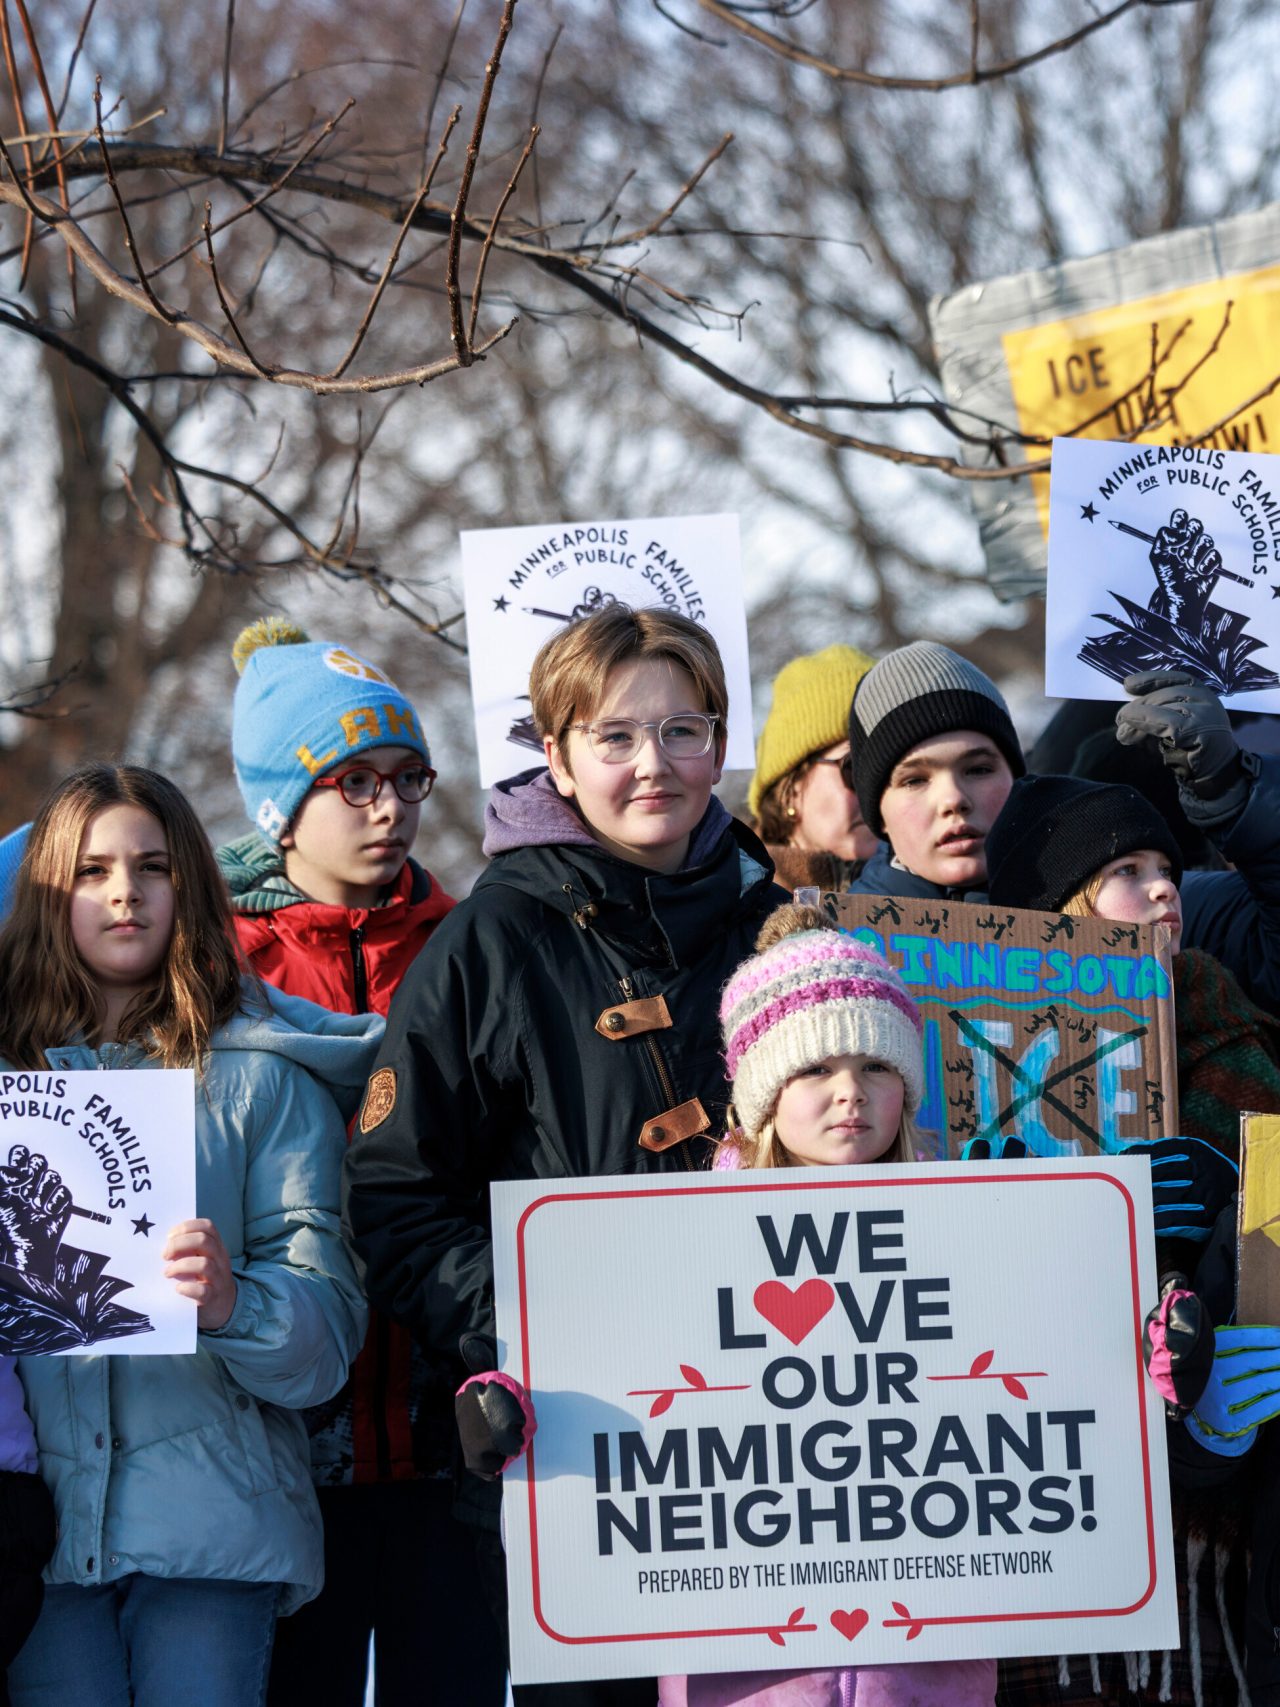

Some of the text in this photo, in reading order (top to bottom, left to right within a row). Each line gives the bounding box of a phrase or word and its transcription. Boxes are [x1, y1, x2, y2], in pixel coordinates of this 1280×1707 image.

[1047, 345, 1111, 400] ICE
[1098, 446, 1226, 501] MINNEAPOLIS
[1136, 469, 1268, 576] FOR PUBLIC SCHOOLS
[508, 527, 706, 622] MINNEAPOLIS FAMILIES
[546, 560, 568, 577] FOR
[574, 549, 637, 569] PUBLIC
[296, 703, 430, 777] LAK
[0, 1073, 152, 1194] POLIS FAMILIES
[1, 1100, 126, 1210] PUBLIC SCHOOLS
[756, 1209, 908, 1277] WE
[761, 1352, 920, 1410] OUR
[593, 1409, 1097, 1494] IMMIGRANT
[597, 1475, 1098, 1556] NEIGHBORS!
[638, 1550, 1053, 1594] PREPARED BY THE IMMIGRANT DEFENSE NETWORK
